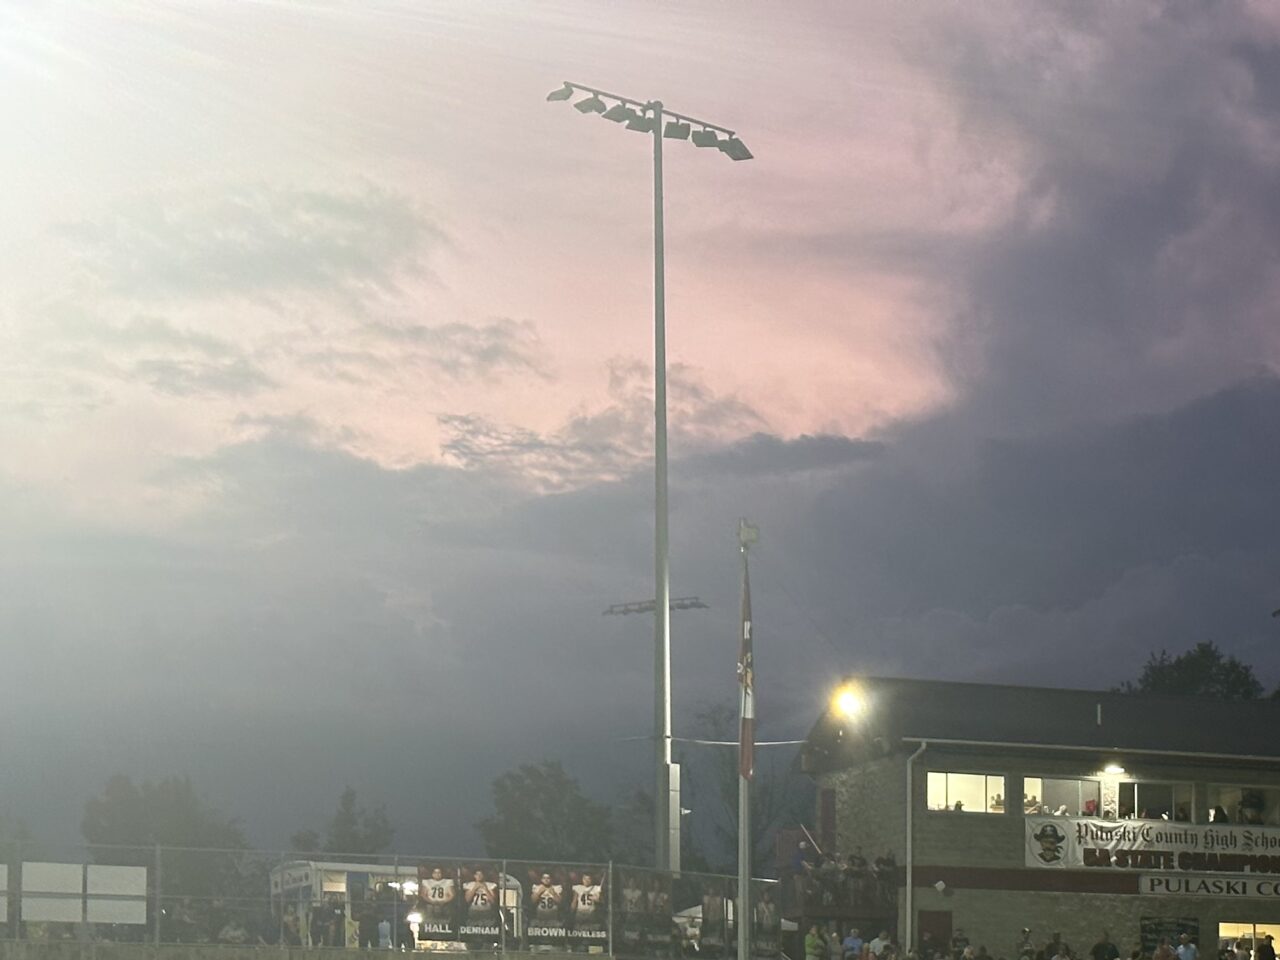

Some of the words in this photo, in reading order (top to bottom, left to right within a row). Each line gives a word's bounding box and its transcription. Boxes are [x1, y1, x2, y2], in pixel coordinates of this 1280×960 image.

[1076, 822, 1137, 845] Pulaski
[1142, 823, 1198, 848] County
[1203, 828, 1238, 850] High
[1115, 849, 1174, 870] STATE
[1150, 878, 1247, 896] PULASKI
[581, 894, 592, 906] 45
[425, 924, 452, 933] HALL
[528, 927, 566, 937] BROWN
[567, 930, 606, 938] LOVELESS
